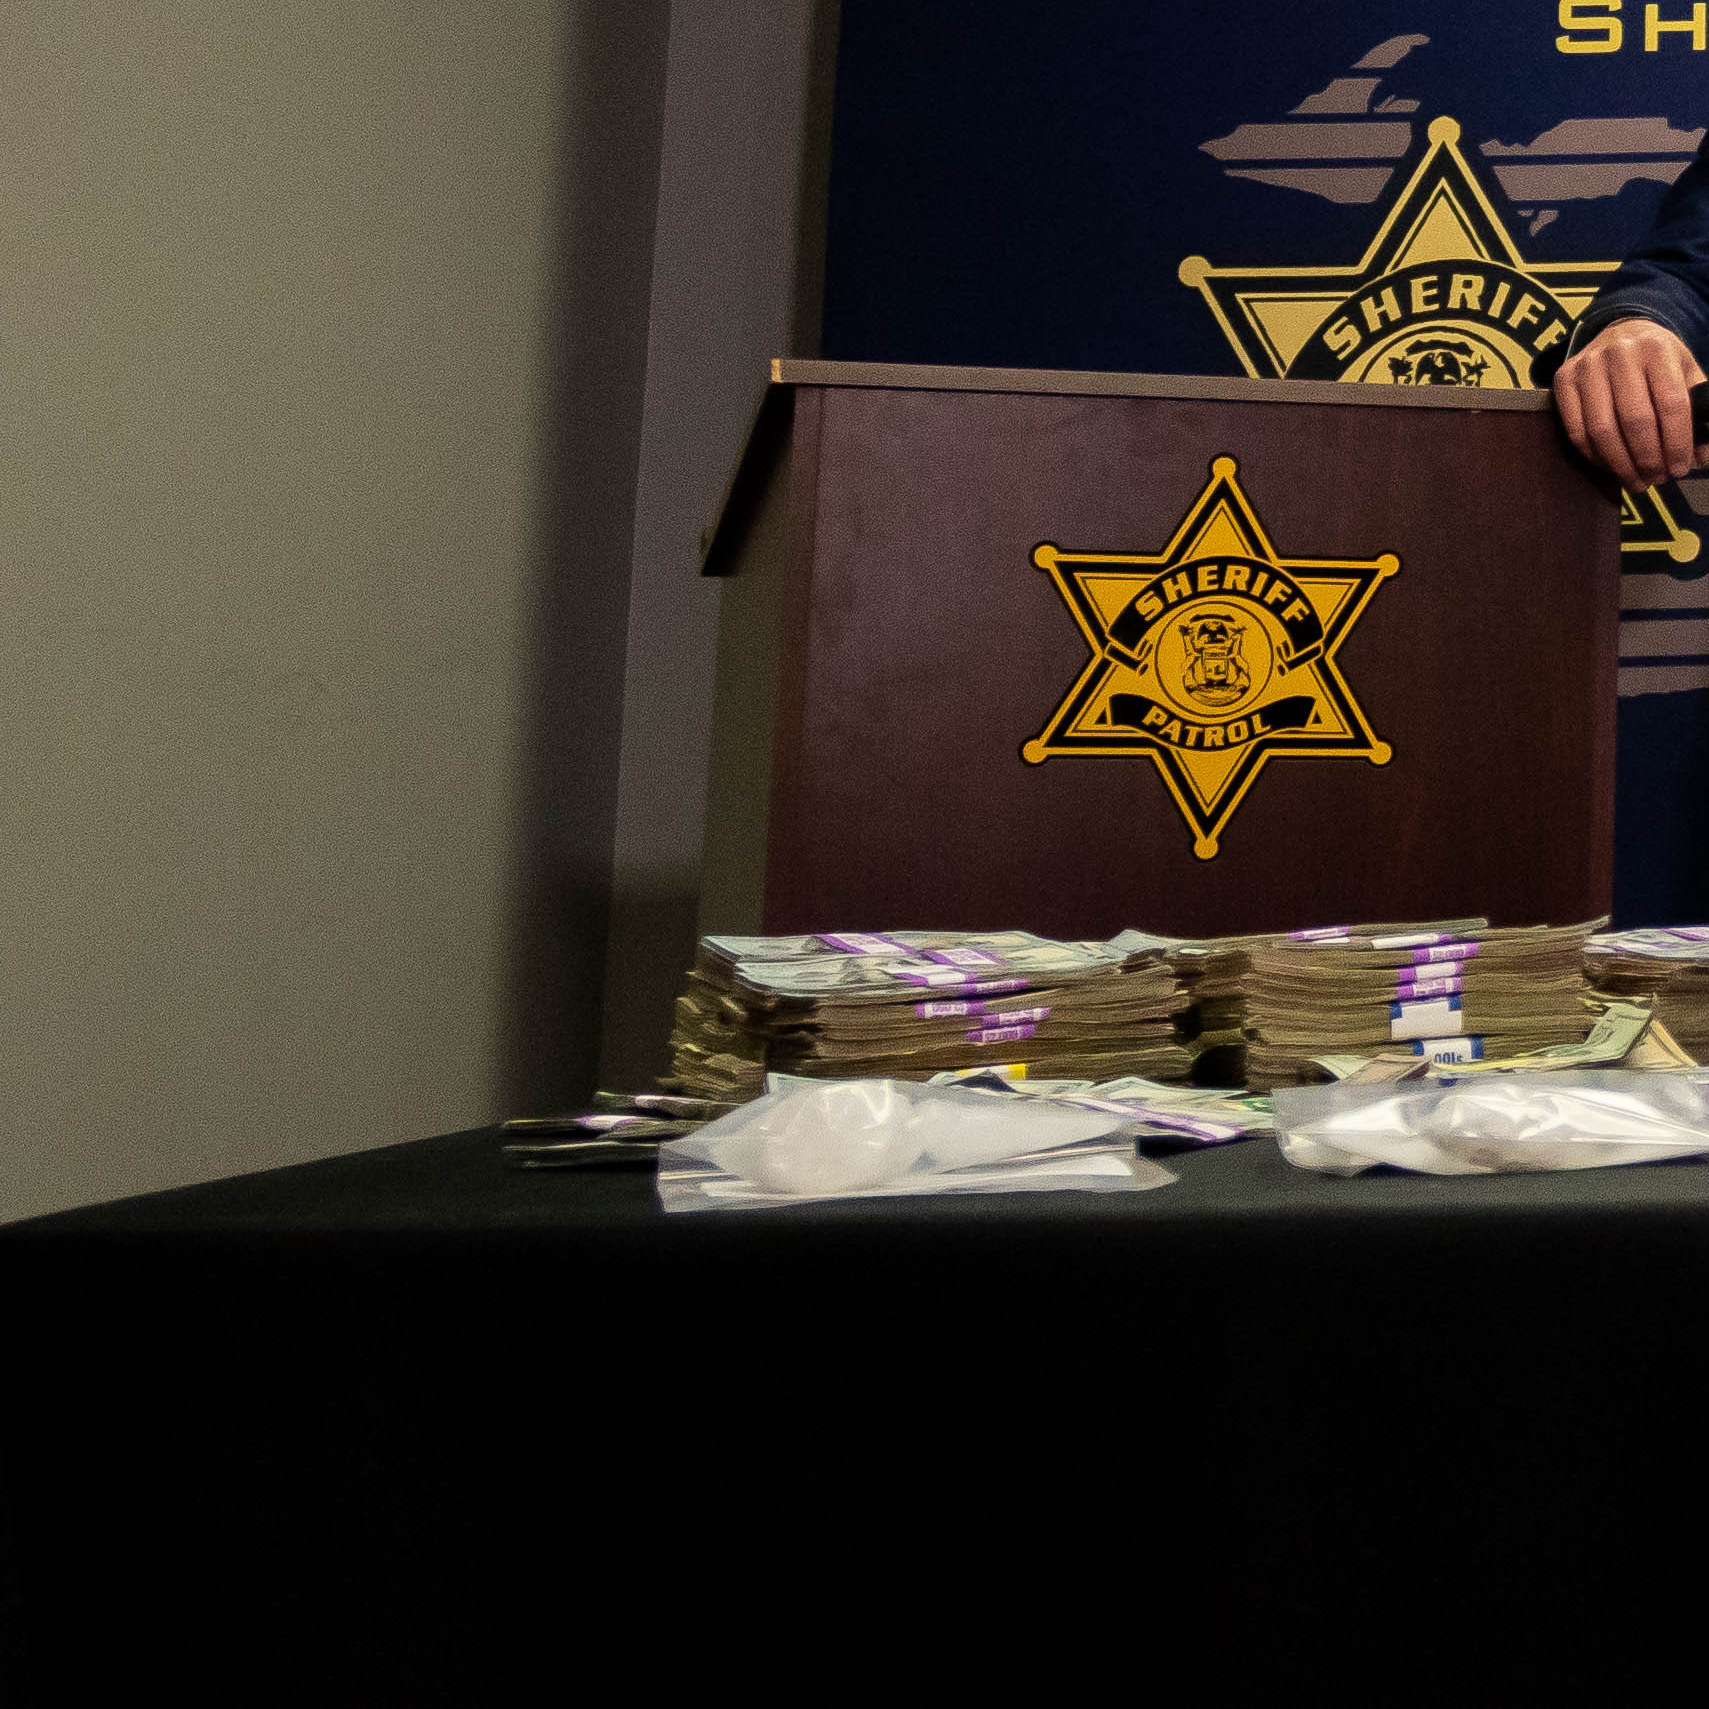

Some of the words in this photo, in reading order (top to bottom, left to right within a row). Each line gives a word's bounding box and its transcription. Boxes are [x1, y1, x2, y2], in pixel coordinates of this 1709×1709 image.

[1322, 273, 1568, 361] SHERIFF
[1135, 564, 1310, 622] SHERIFF
[1142, 705, 1271, 747] PATROL
